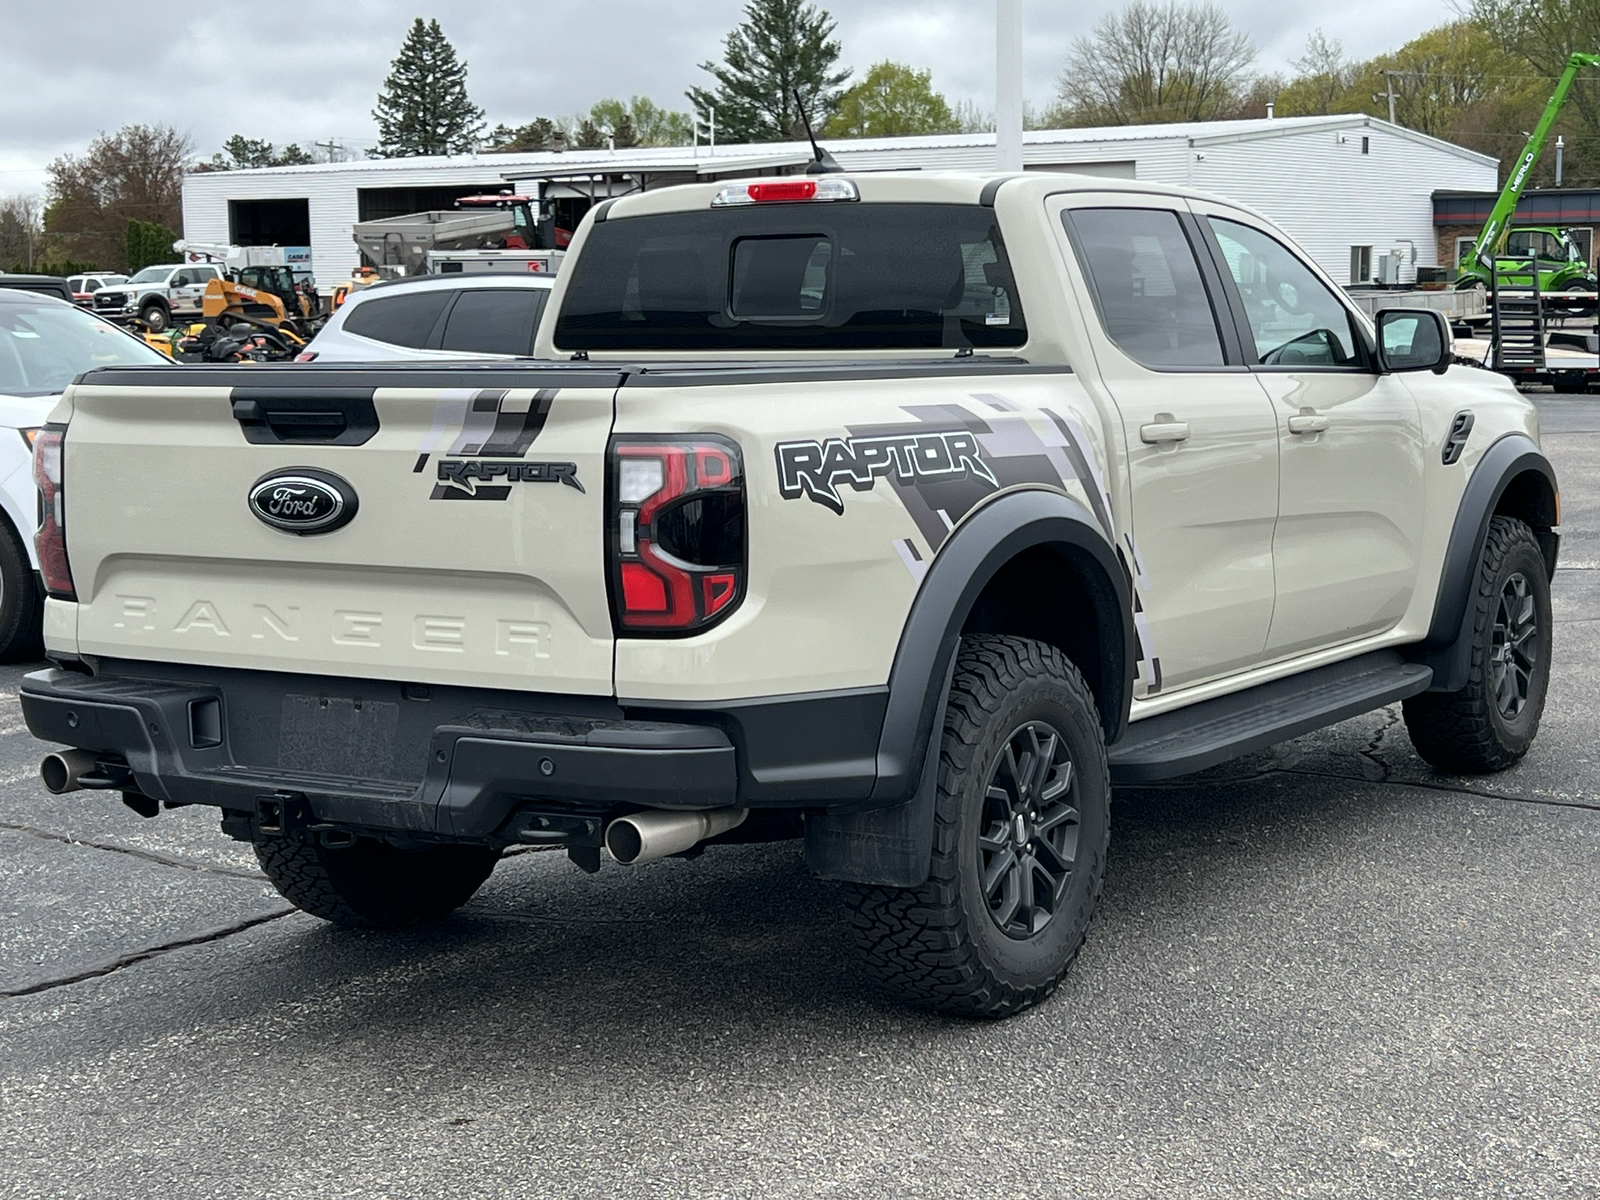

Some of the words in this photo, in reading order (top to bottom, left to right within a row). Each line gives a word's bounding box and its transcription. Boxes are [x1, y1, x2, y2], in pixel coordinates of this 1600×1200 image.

[1510, 153, 1534, 191] MERLO
[234, 284, 257, 297] CASE
[437, 460, 586, 496] RAPTOR
[774, 430, 1000, 516] RAPTOR
[269, 487, 318, 515] Ford
[113, 593, 551, 659] RANGER
